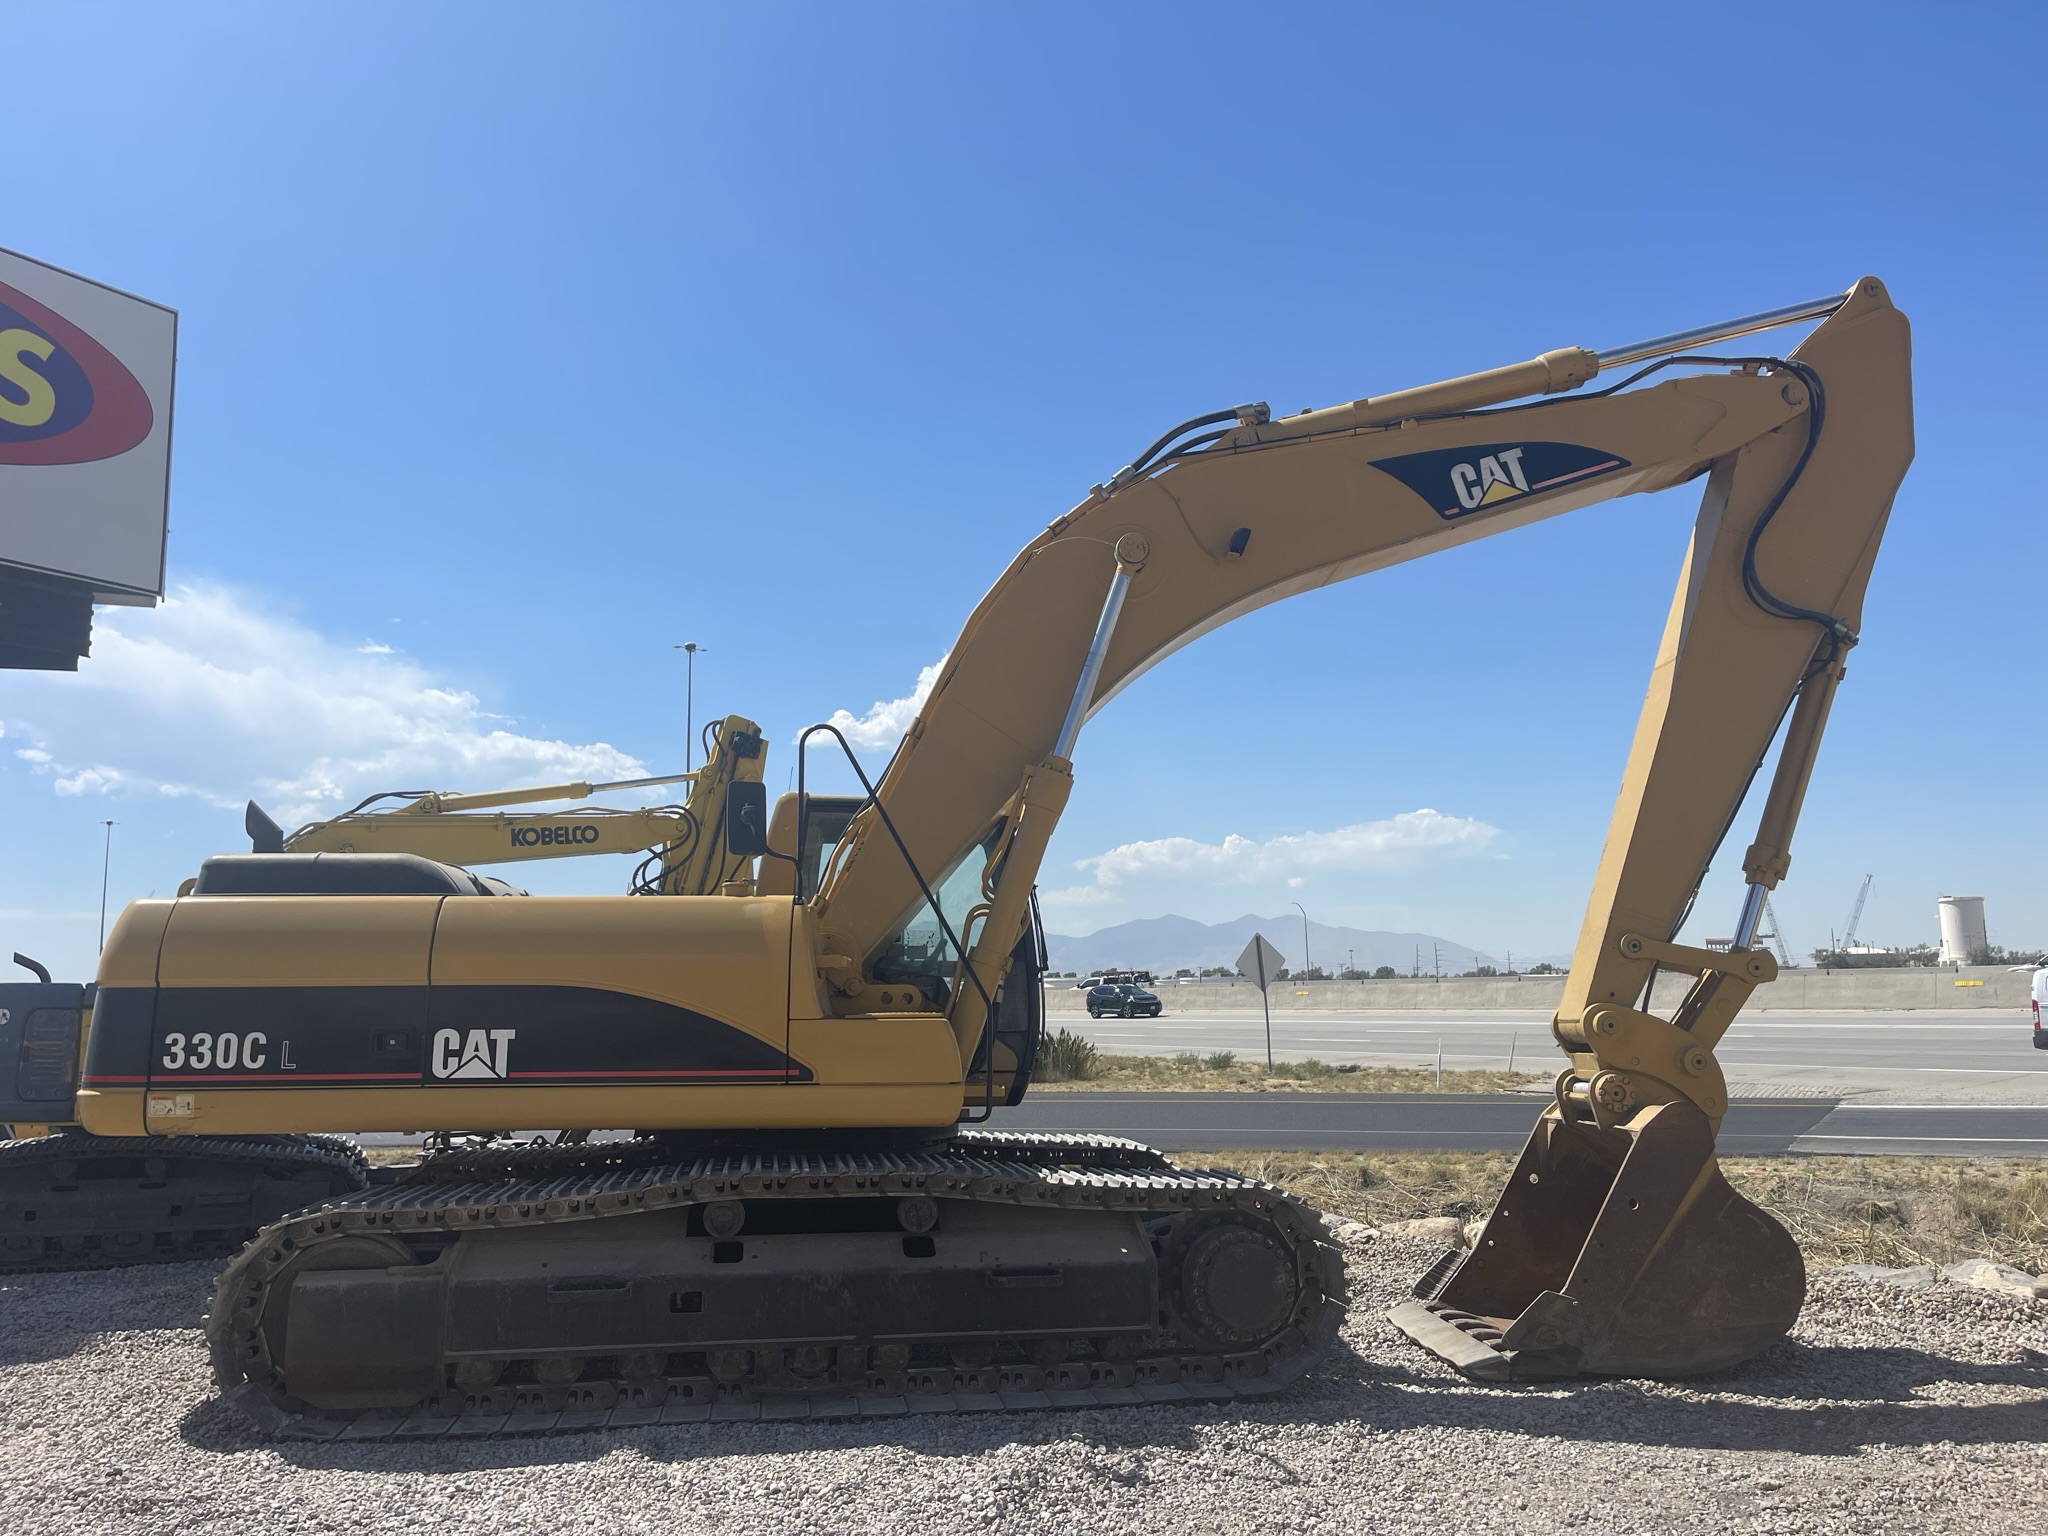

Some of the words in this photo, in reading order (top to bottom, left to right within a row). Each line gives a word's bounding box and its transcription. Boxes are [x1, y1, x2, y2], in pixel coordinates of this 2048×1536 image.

[1450, 447, 1530, 509] CAT
[510, 825, 599, 847] KOBELCO
[162, 1031, 267, 1070] 330C
[280, 1040, 297, 1069] L
[431, 1028, 516, 1079] CAT
